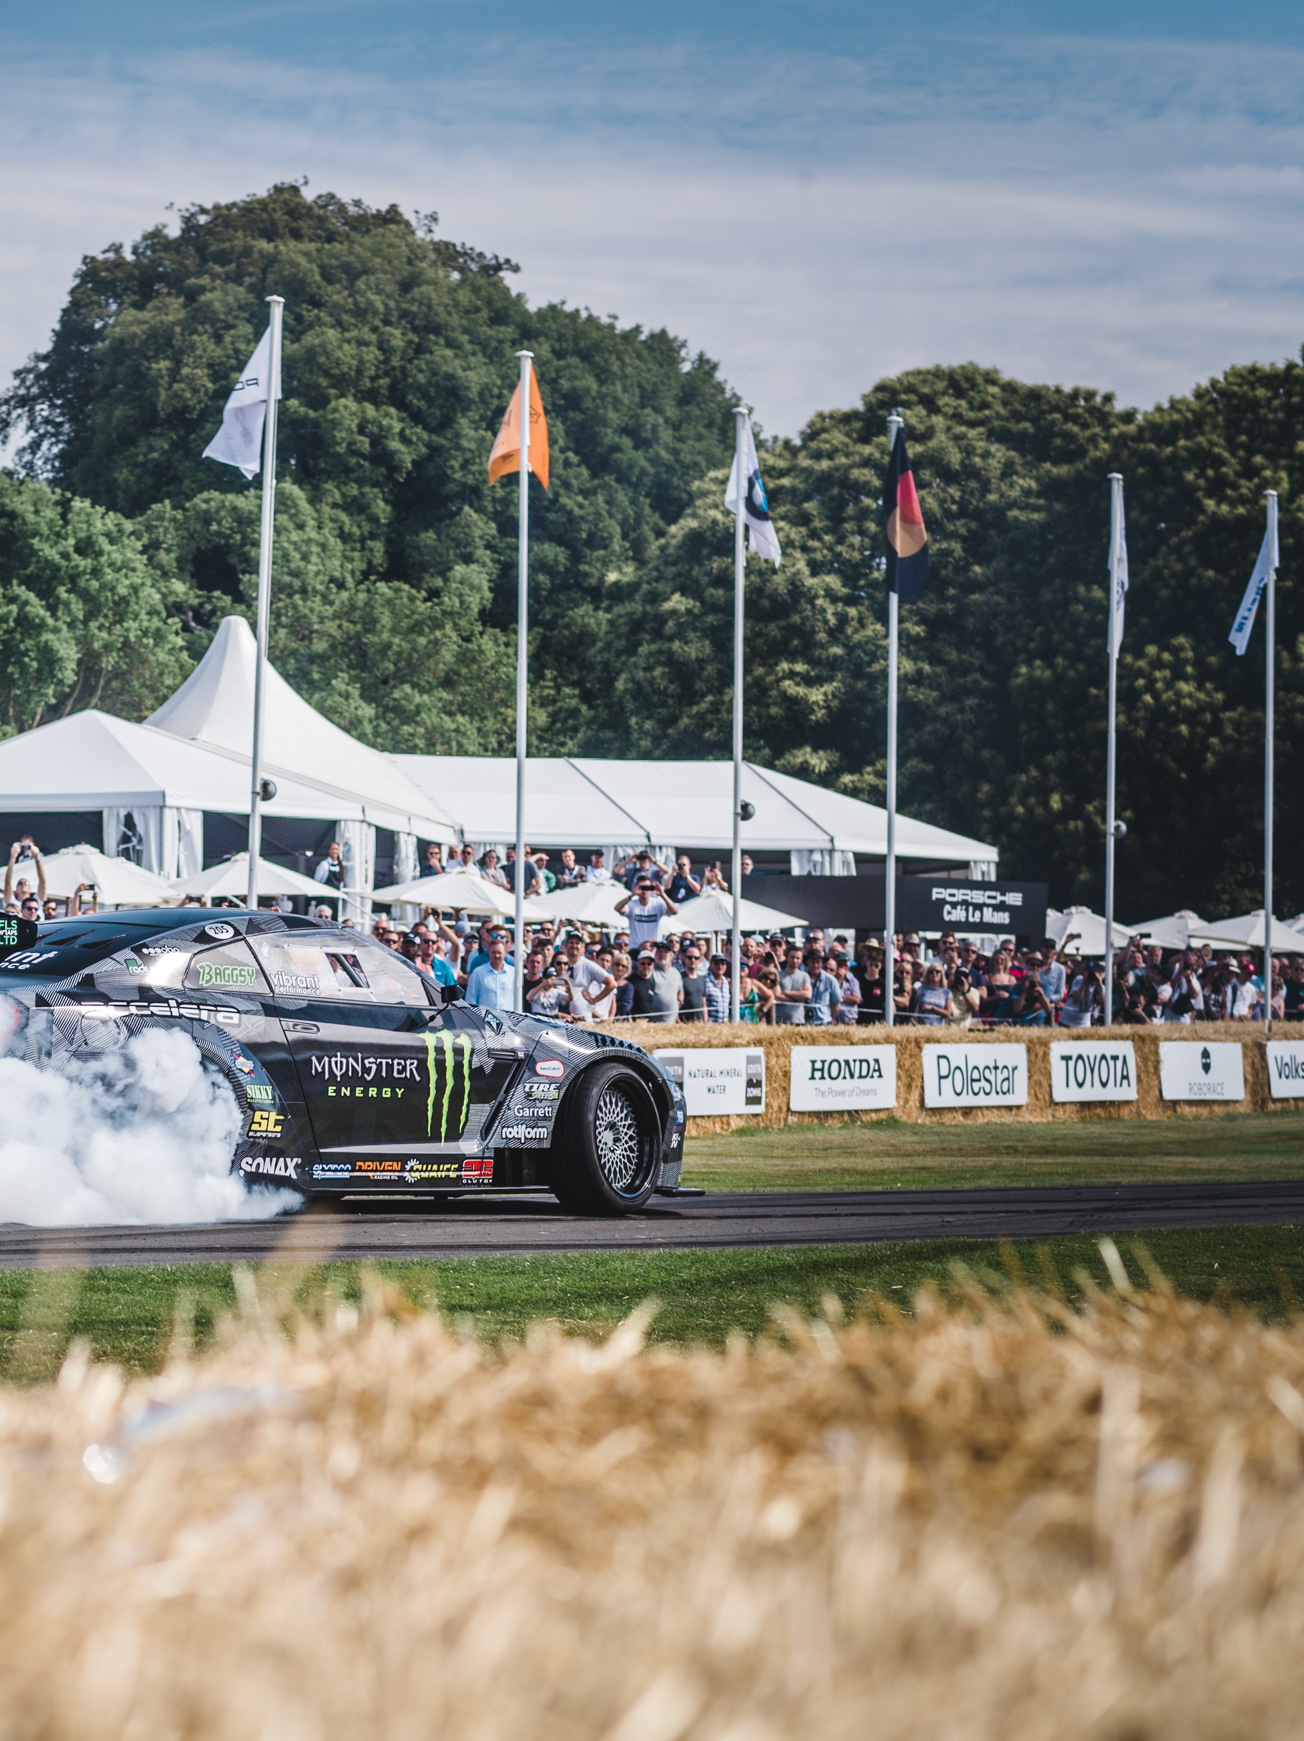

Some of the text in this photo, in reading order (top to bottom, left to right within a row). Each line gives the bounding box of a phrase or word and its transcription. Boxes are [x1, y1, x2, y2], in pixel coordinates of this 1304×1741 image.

[932, 888, 1023, 905] PORSCHE
[943, 904, 1010, 925] Café Le Mans
[209, 924, 229, 935] 205
[198, 962, 256, 987] BAGGSY
[269, 972, 320, 989] vibrant
[311, 1052, 421, 1082] MONSTER
[688, 1068, 743, 1079] NATURAL MINERAL
[747, 1064, 761, 1074] SOUTH
[808, 1058, 883, 1080] HONDA
[1060, 1053, 1131, 1089] TOYOTA
[936, 1054, 1018, 1097] Polestar
[246, 1084, 273, 1100] SIKKY
[328, 1086, 405, 1098] ENERGY
[524, 1083, 560, 1091] TIRE
[707, 1085, 726, 1095] WATER
[814, 1086, 877, 1098] The Power of Dreams
[1188, 1082, 1225, 1096] ROBORACE
[515, 1105, 553, 1117] Garrett
[502, 1124, 548, 1143] rotiform
[356, 1162, 401, 1180] DRIVEN
